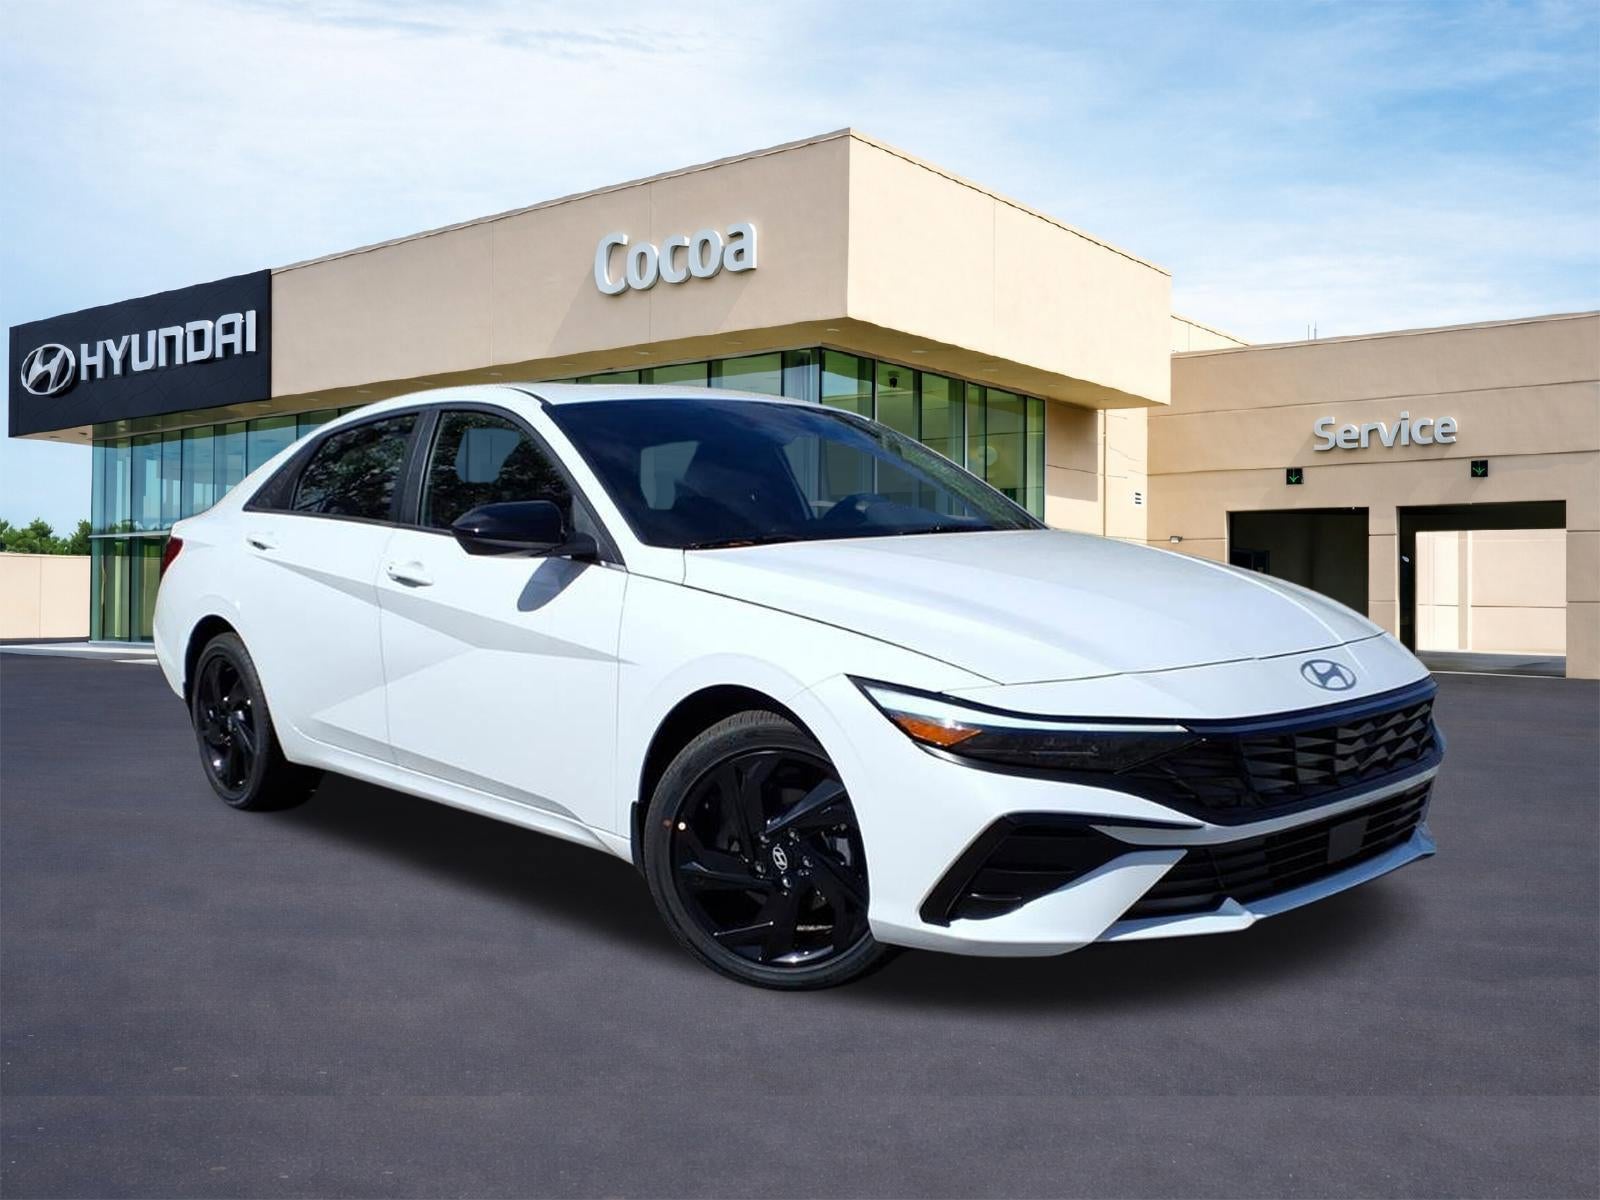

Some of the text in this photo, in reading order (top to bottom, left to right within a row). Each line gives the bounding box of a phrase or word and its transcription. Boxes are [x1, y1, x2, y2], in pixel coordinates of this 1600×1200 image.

[594, 222, 758, 295] Cocoa
[80, 310, 257, 381] HYUNDAI
[1313, 411, 1458, 451] Service
